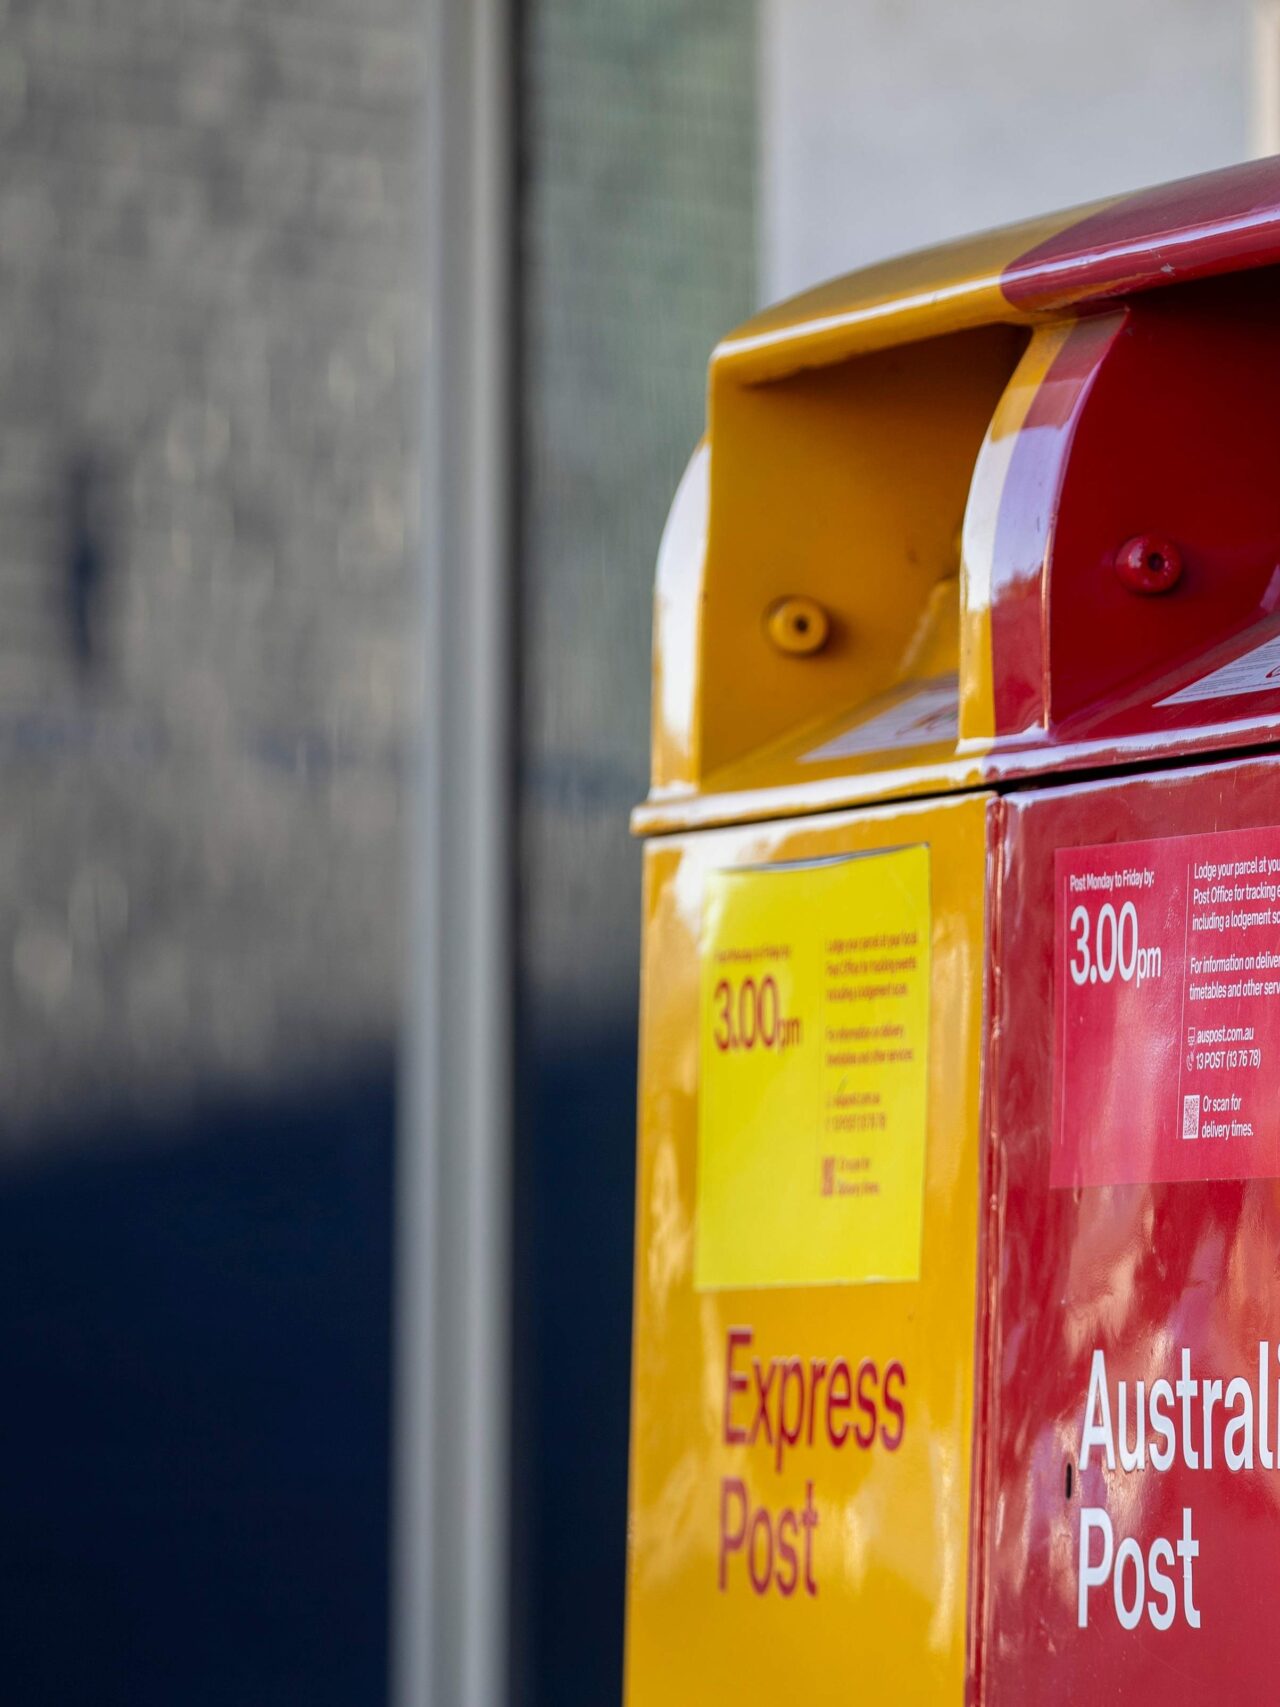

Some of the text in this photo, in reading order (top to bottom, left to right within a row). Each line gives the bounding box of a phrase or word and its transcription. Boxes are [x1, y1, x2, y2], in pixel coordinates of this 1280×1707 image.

[1070, 867, 1154, 892] Post Monday to Friday by:
[1194, 861, 1216, 881] Lodge
[1218, 862, 1234, 880] your
[1235, 856, 1258, 878] parcel
[1259, 856, 1267, 873] at
[1193, 888, 1210, 904] Post
[1211, 886, 1233, 904] Office
[1234, 884, 1245, 901] for
[1246, 881, 1276, 902] tracking
[1192, 912, 1224, 932] including
[1225, 915, 1230, 928] a
[1231, 908, 1271, 930] lodgement
[1070, 901, 1161, 988] 3.00pm
[1190, 957, 1202, 974] For
[1203, 954, 1244, 974] information
[1245, 957, 1254, 970] on
[1190, 981, 1227, 1000] timetables
[1228, 980, 1242, 997] and
[1242, 978, 1263, 996] other
[714, 975, 802, 1056] 3.00pm
[1197, 1025, 1254, 1046] auspost.com.au
[1196, 1048, 1261, 1070] 13 POST (13 76 78)
[1203, 1093, 1242, 1112] Or scan for
[1202, 1120, 1254, 1140] delivery times.
[723, 1325, 906, 1475] Express
[717, 1476, 818, 1598] Post
[1078, 1508, 1200, 1630] Post
